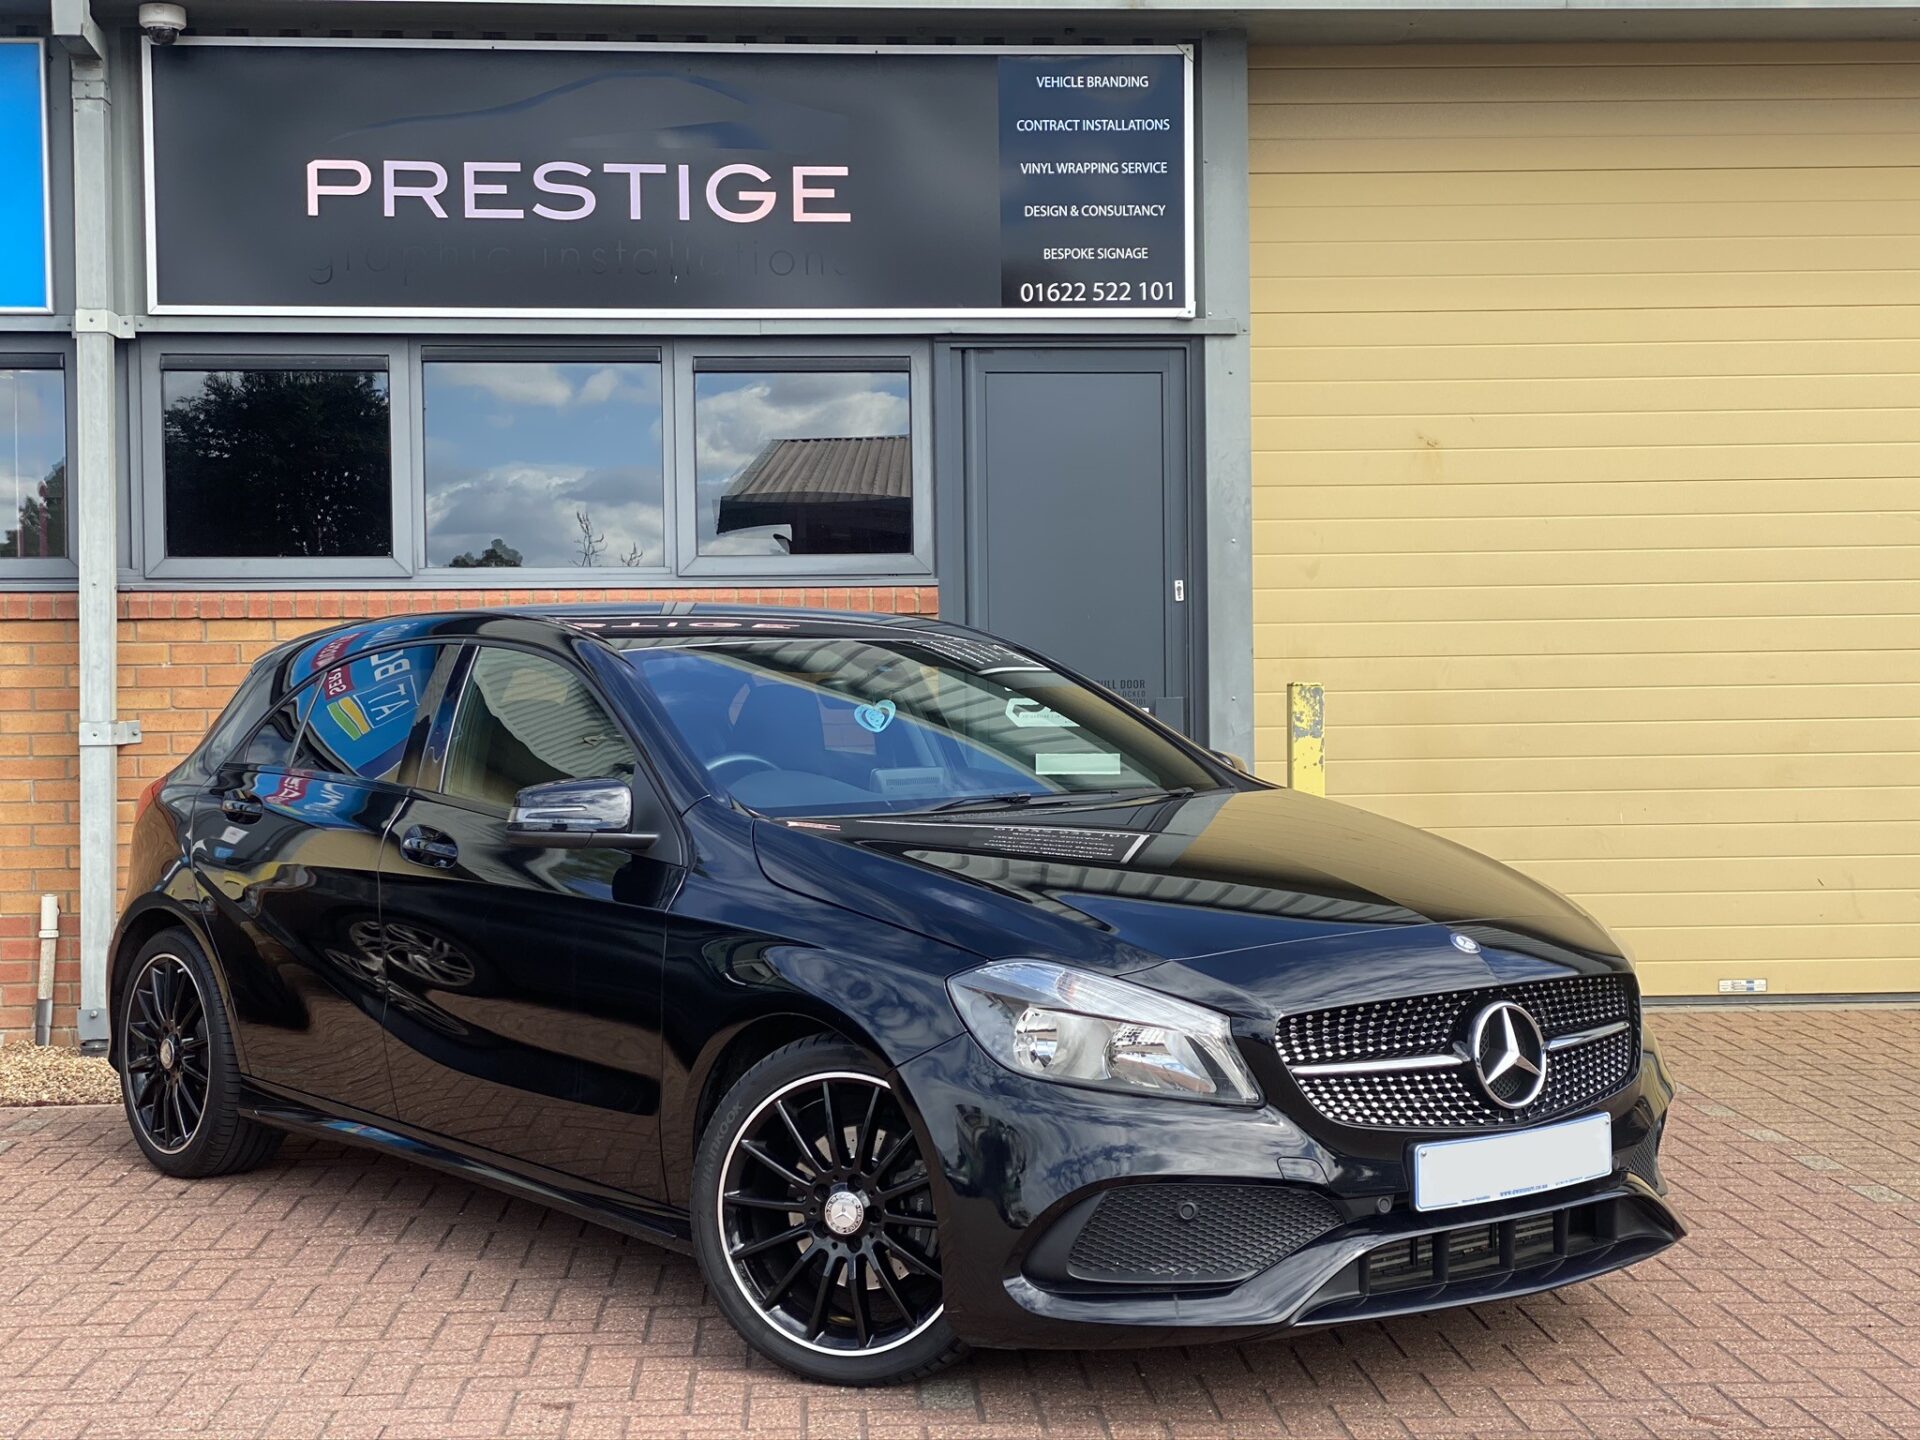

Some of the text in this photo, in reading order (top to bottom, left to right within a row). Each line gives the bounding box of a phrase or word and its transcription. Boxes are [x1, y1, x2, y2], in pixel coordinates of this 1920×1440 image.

[1036, 76, 1149, 88] VEHICLE BRANDING
[1016, 119, 1171, 131] CONTRACT INSTALLATIONS
[1020, 162, 1168, 174] VINYL WRAPPING SERVICE
[307, 159, 852, 224] PRESTIGE
[1024, 204, 1166, 217] DESIGN & CONSULTANCY
[1043, 247, 1148, 260] BESPOKE SIGNAGE
[1020, 281, 1174, 302] 01622 522 101
[1120, 680, 1146, 689] DOOR
